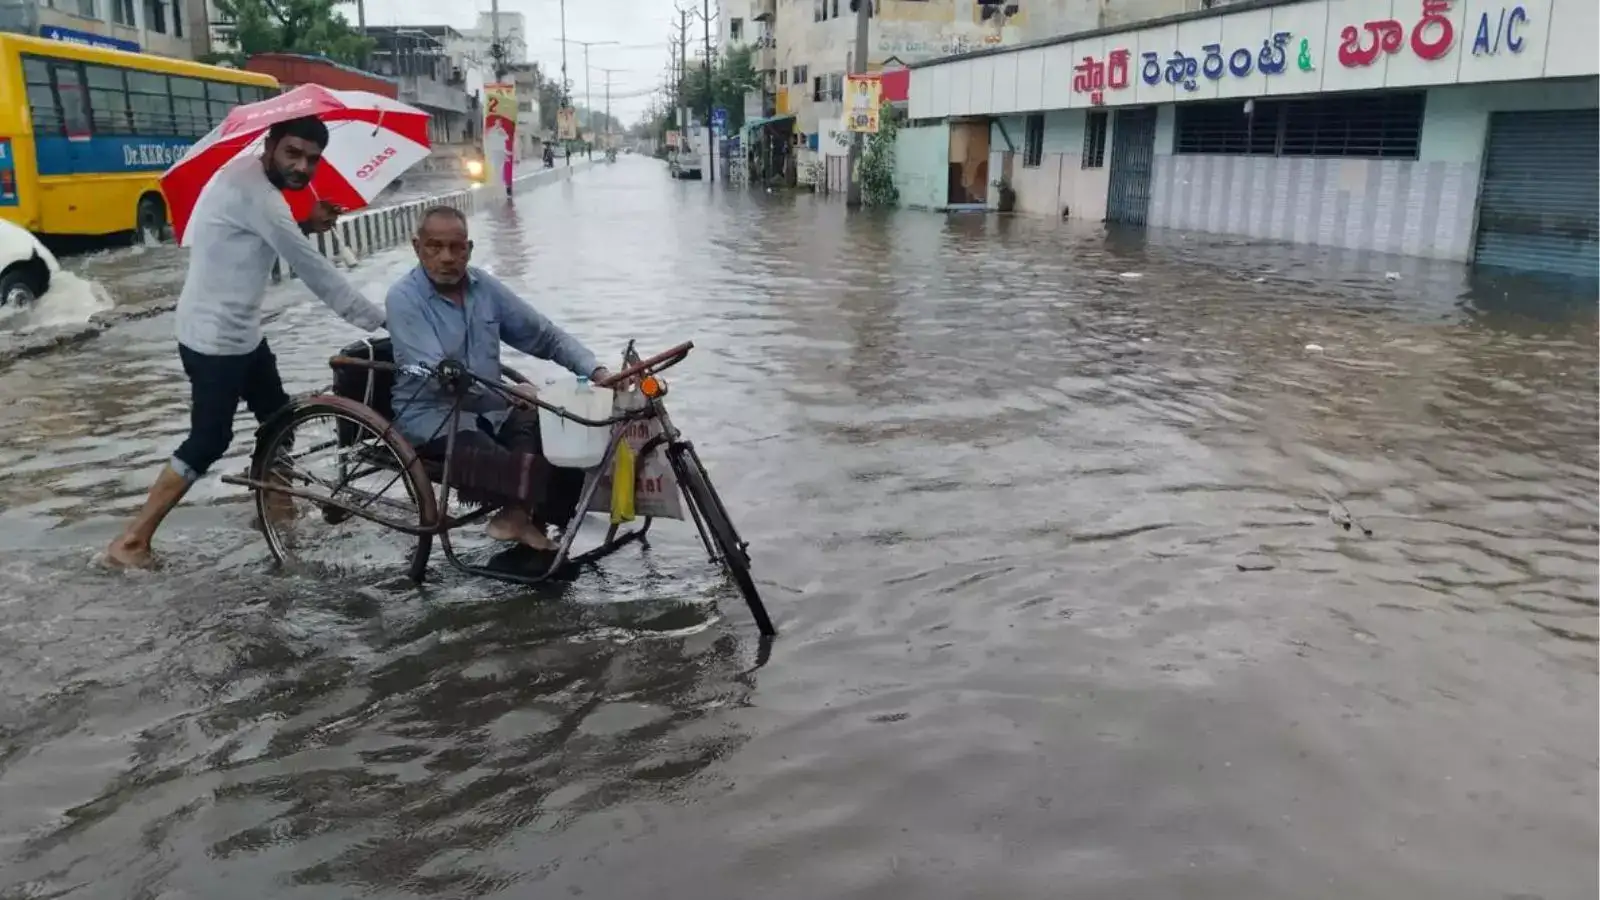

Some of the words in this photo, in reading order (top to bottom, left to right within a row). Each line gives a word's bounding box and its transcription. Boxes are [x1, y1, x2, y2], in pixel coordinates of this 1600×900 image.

[1297, 38, 1315, 71] &
[1338, 0, 1454, 68] బార్
[1472, 6, 1528, 56] A/C
